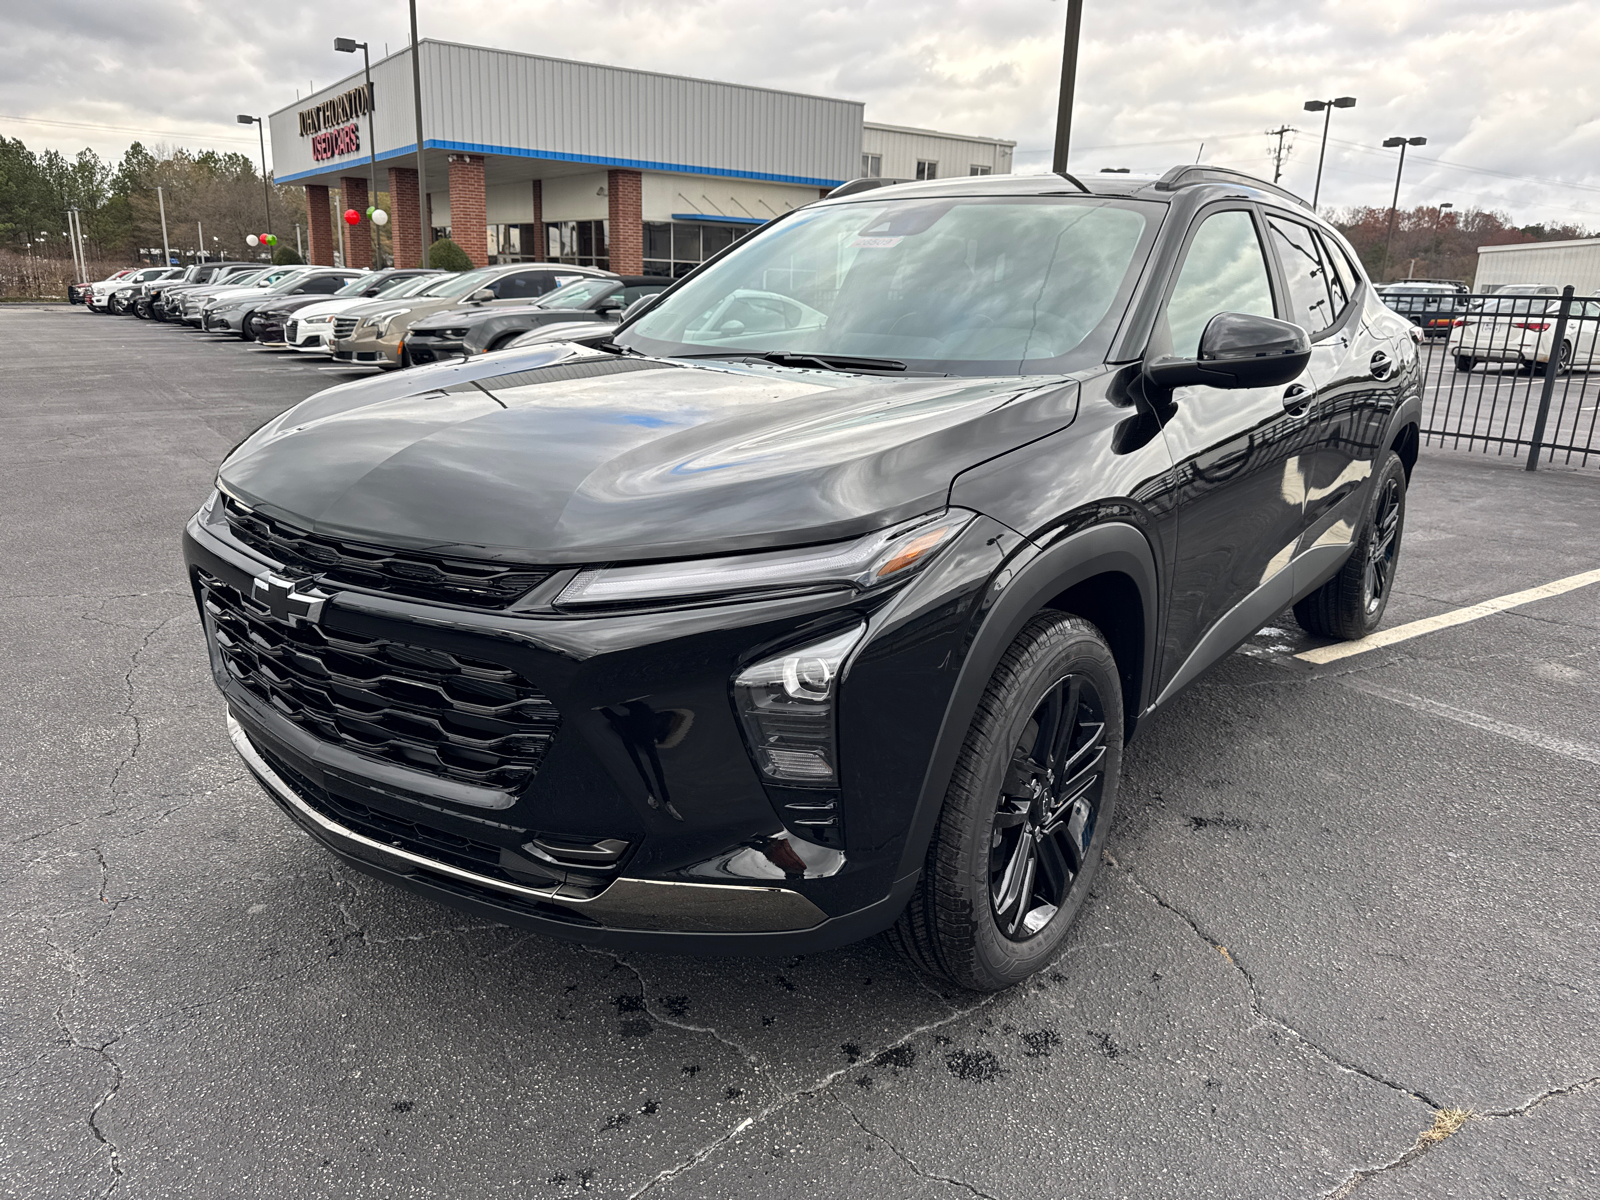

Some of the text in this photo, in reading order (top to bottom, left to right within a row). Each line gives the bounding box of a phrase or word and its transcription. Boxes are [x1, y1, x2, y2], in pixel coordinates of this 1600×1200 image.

[298, 82, 375, 137] JOHN THORNTON
[311, 123, 359, 161] USED CARS
